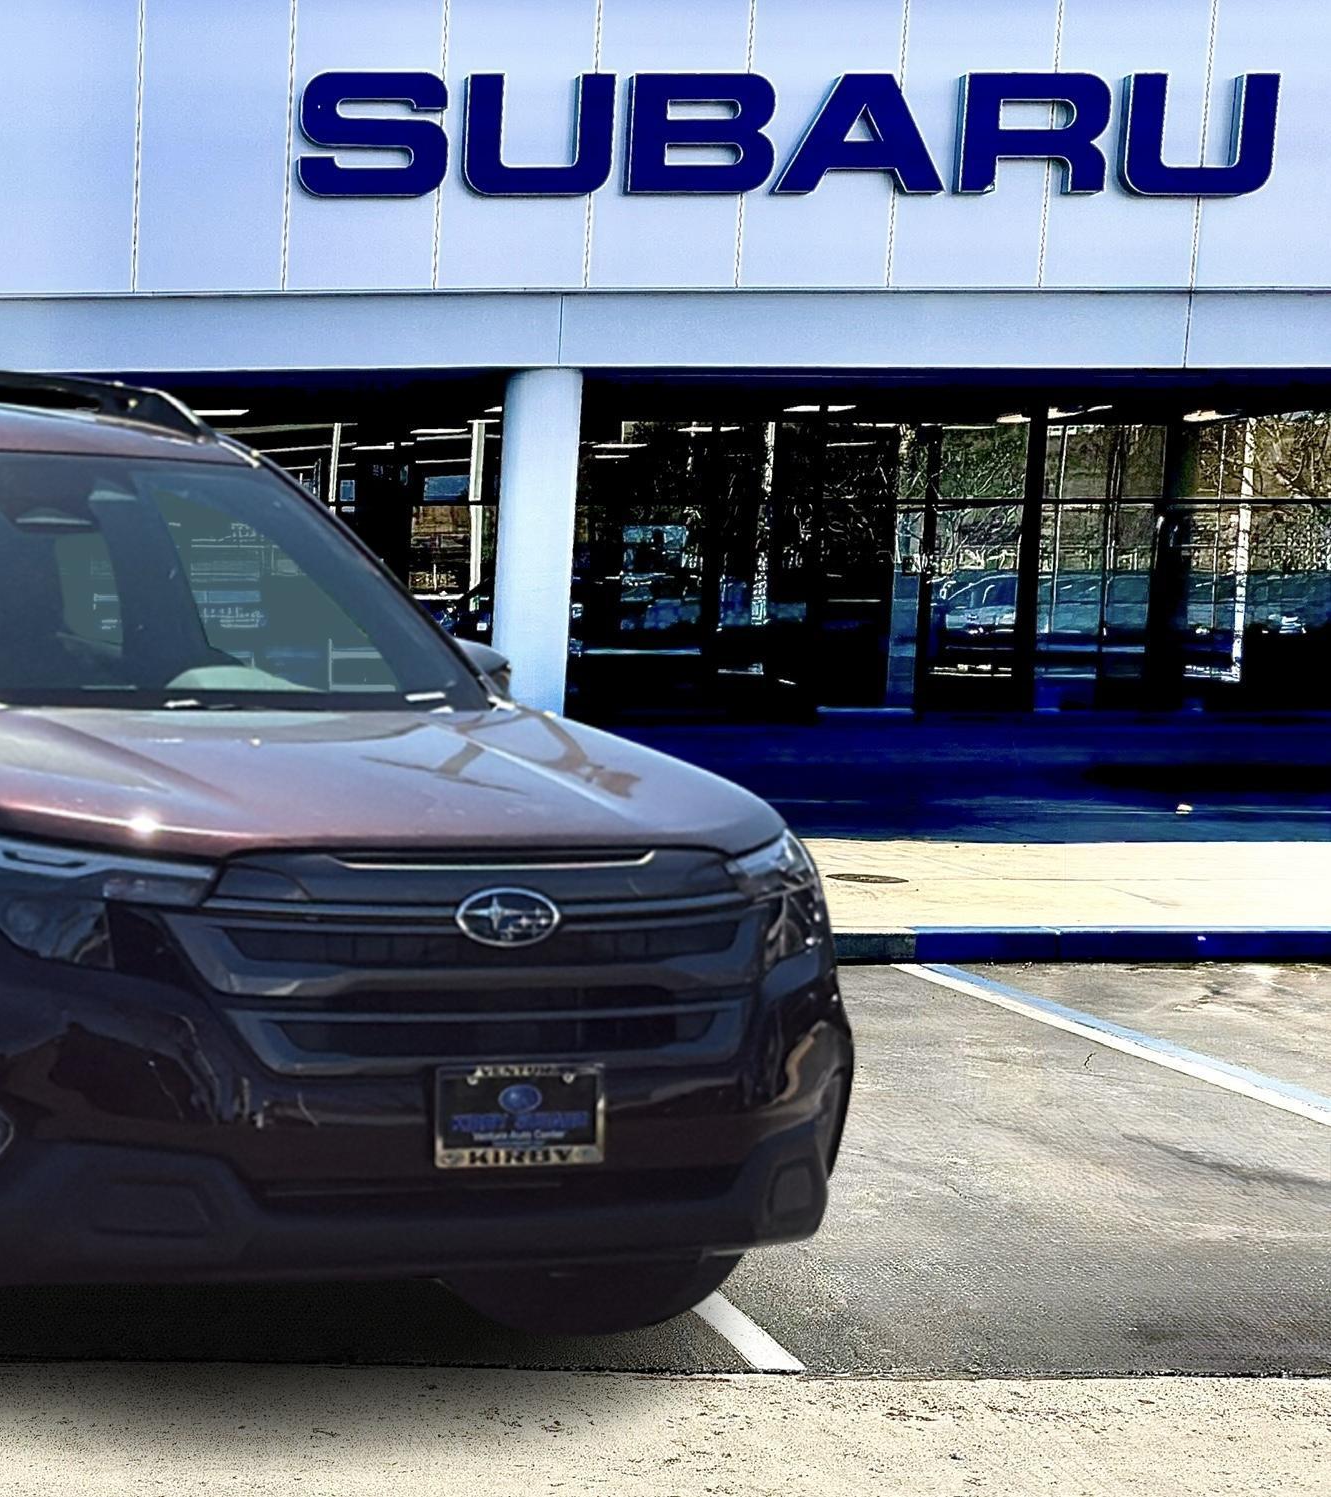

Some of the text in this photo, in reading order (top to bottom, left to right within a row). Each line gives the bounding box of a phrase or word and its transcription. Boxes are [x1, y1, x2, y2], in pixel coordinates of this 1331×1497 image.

[296, 71, 1281, 197] SUBARU
[472, 1128, 567, 1141] Ventura Auto Center
[469, 1148, 574, 1165] KIRBY
